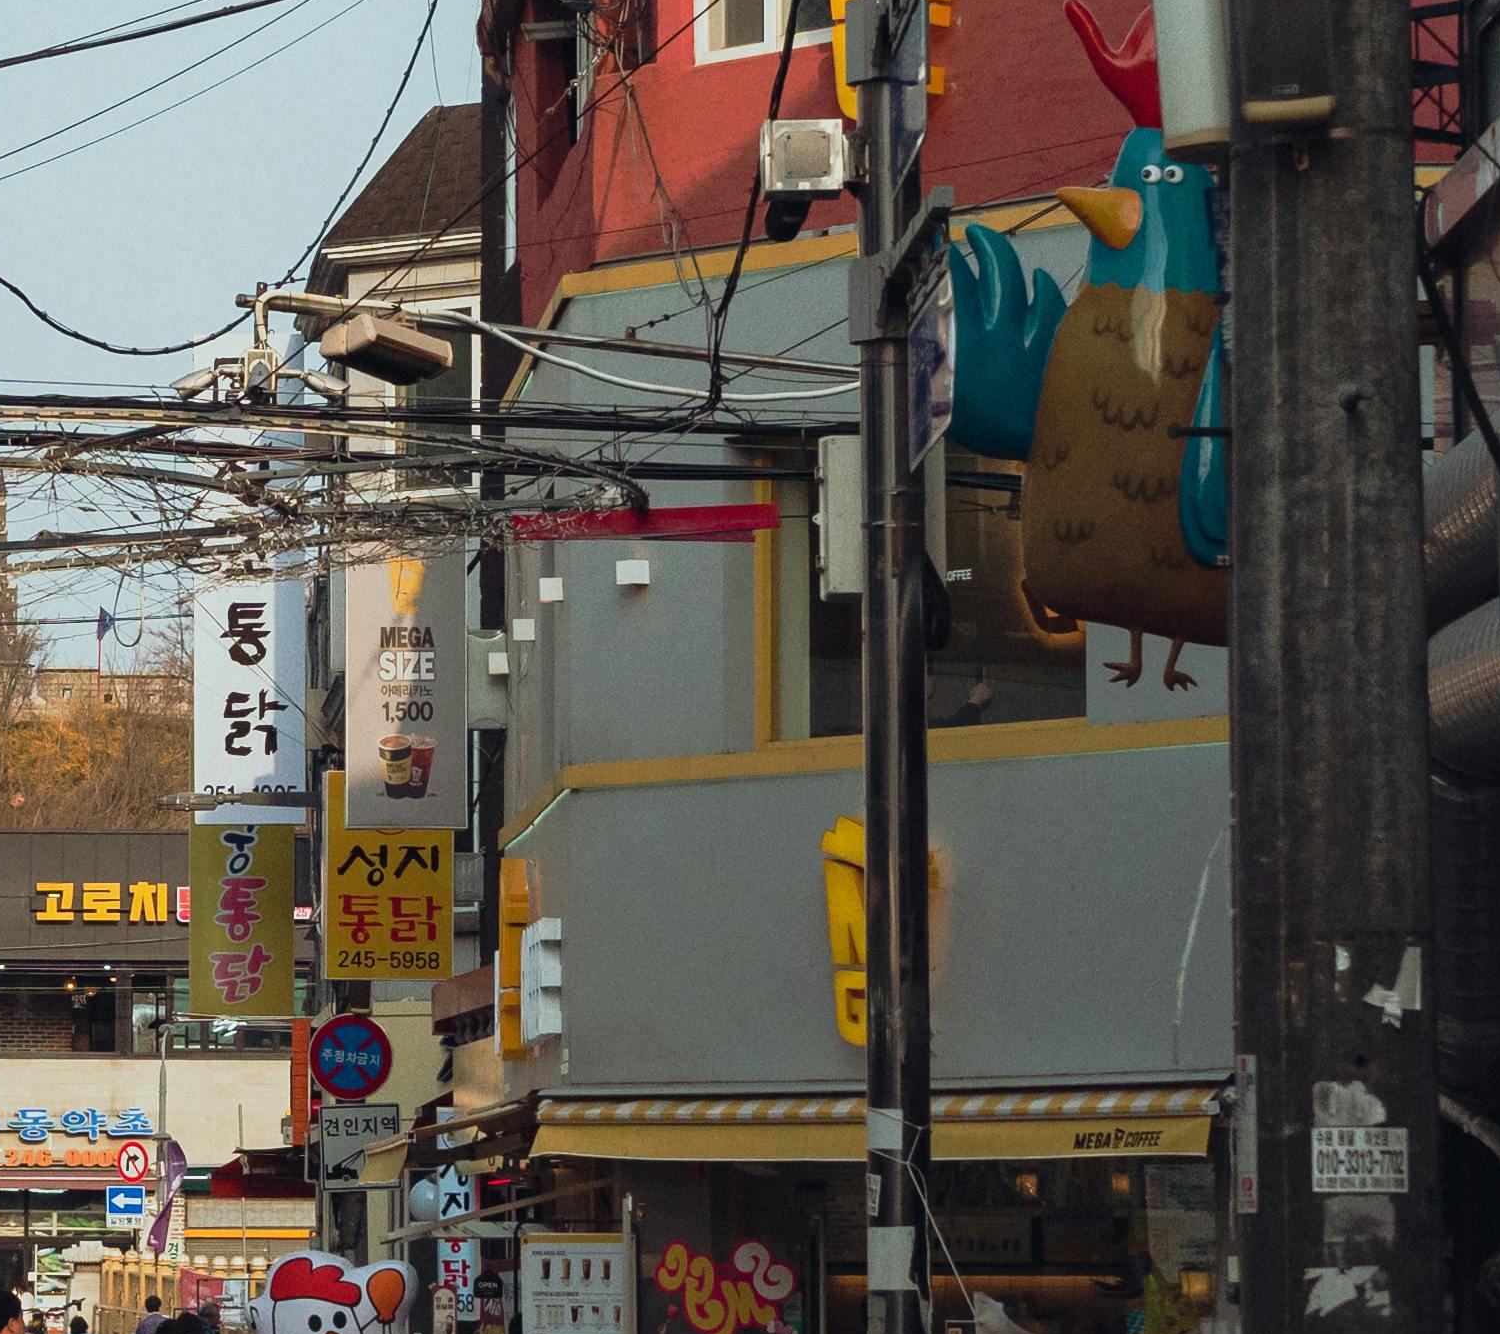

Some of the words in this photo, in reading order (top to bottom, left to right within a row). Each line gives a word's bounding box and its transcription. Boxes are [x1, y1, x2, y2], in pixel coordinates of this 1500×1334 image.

[379, 626, 435, 649] MEGA
[378, 650, 436, 682] SIZE
[380, 684, 434, 697] 아메리카노
[381, 700, 434, 723] 1,500
[336, 844, 440, 887] 성지
[338, 893, 443, 944] 통닭
[337, 950, 440, 969] 245-5958
[322, 1114, 399, 1138] 견인지역
[1073, 1132, 1112, 1150] MEGA
[1123, 1129, 1164, 1148] COFFEE
